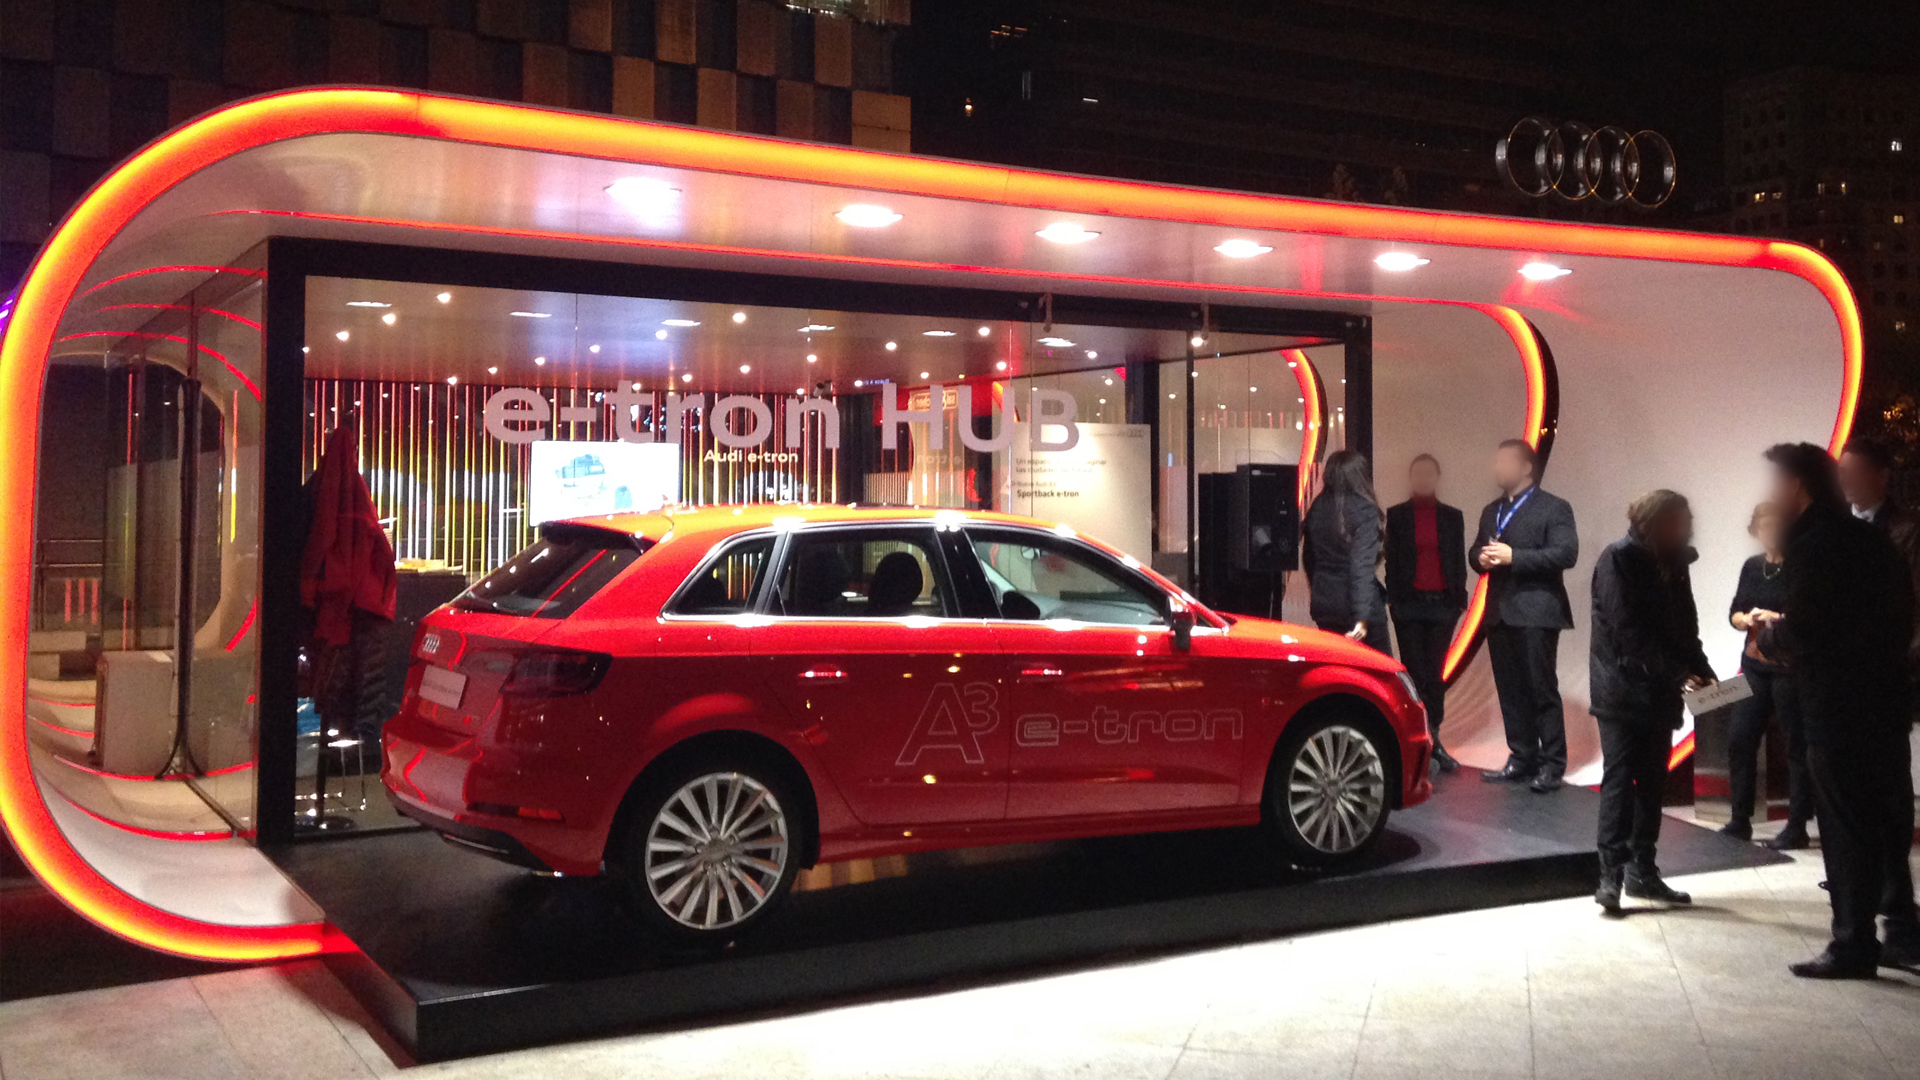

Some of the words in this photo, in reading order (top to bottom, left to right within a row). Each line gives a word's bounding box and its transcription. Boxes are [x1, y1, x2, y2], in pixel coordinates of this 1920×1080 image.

[486, 380, 839, 449] e-tron
[882, 382, 1080, 452] HUB
[704, 450, 742, 462] Audi
[747, 451, 799, 463] e-tron
[1017, 489, 1055, 498] Sportback
[1057, 490, 1079, 498] e-tron
[895, 682, 1000, 765] A3
[1015, 706, 1243, 746] e-tron
